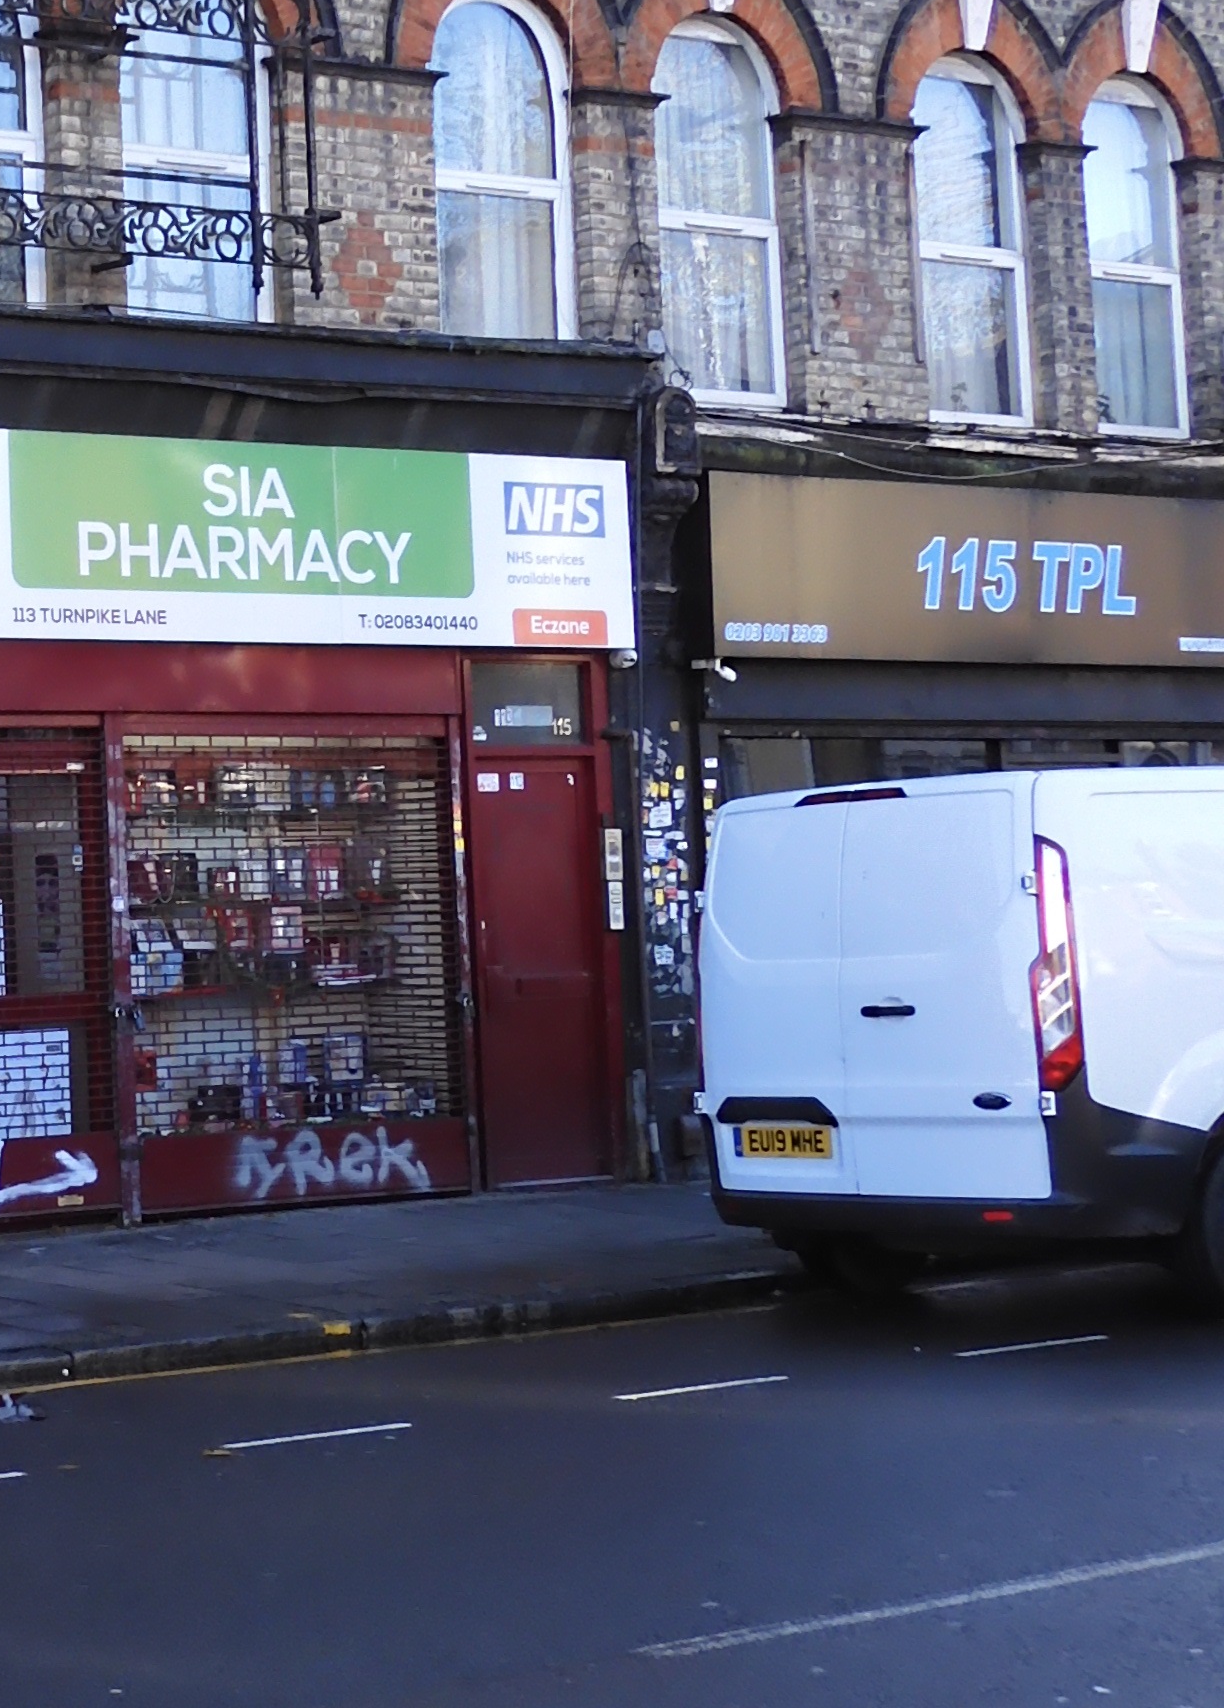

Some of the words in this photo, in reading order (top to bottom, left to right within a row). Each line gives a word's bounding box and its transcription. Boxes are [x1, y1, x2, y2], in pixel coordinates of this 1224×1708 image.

[202, 463, 296, 518] SIA
[508, 486, 600, 534] NHS
[78, 521, 412, 584] PHARMACY
[506, 551, 533, 565] NHS
[536, 552, 585, 567] services
[507, 572, 561, 586] available
[563, 573, 591, 587] here
[917, 536, 1016, 613] 115
[1033, 540, 1137, 616] TPL
[12, 607, 36, 623] 113
[40, 608, 121, 624] TURNPIKE
[124, 610, 167, 625] LANE
[375, 614, 478, 630] 02083401440
[530, 616, 590, 635] Eczane
[725, 622, 762, 642] 0203
[552, 718, 572, 735] 115
[748, 1130, 786, 1152] EU19
[790, 1130, 825, 1153] MHE
